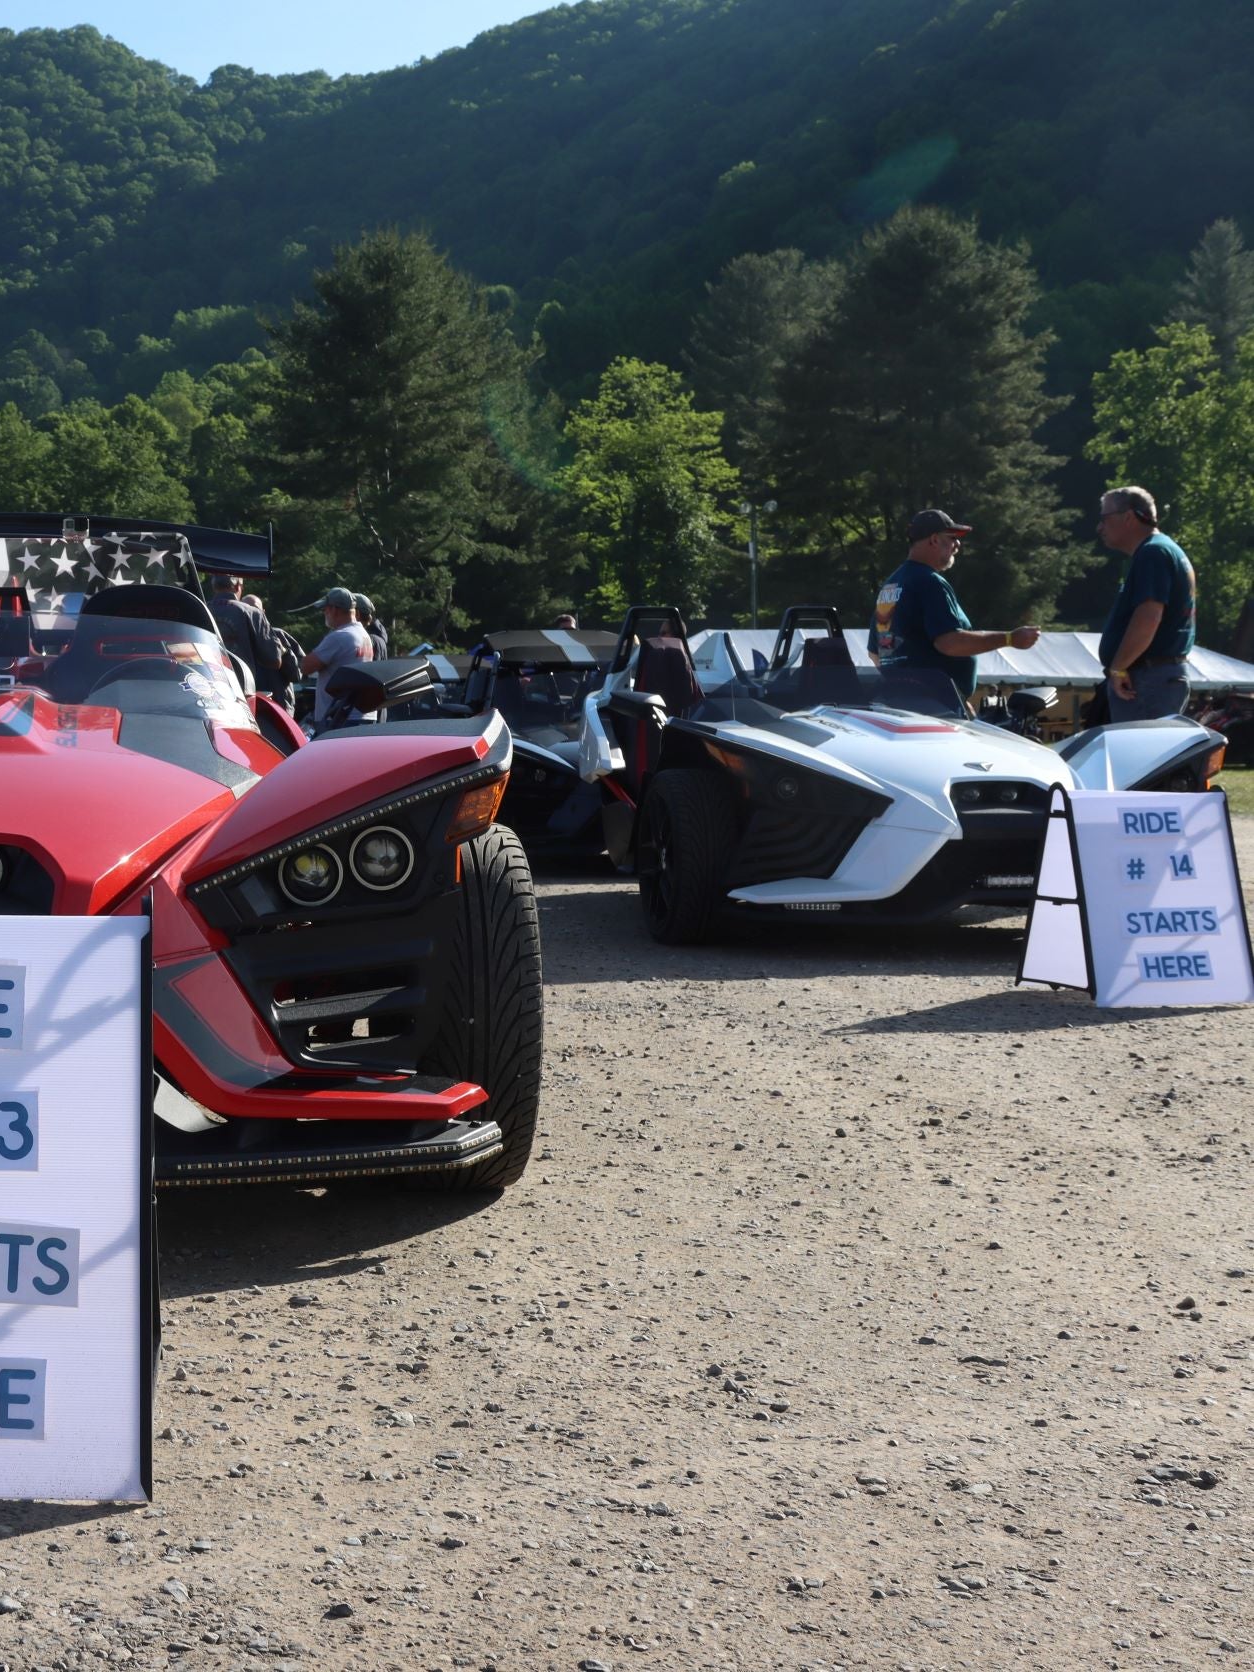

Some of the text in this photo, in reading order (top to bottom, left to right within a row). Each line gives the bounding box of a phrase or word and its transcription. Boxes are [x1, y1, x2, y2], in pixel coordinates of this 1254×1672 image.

[1123, 811, 1181, 834] RIDE
[1126, 854, 1194, 880] # 14
[1126, 910, 1217, 935] STARTS
[1143, 955, 1210, 979] HERE
